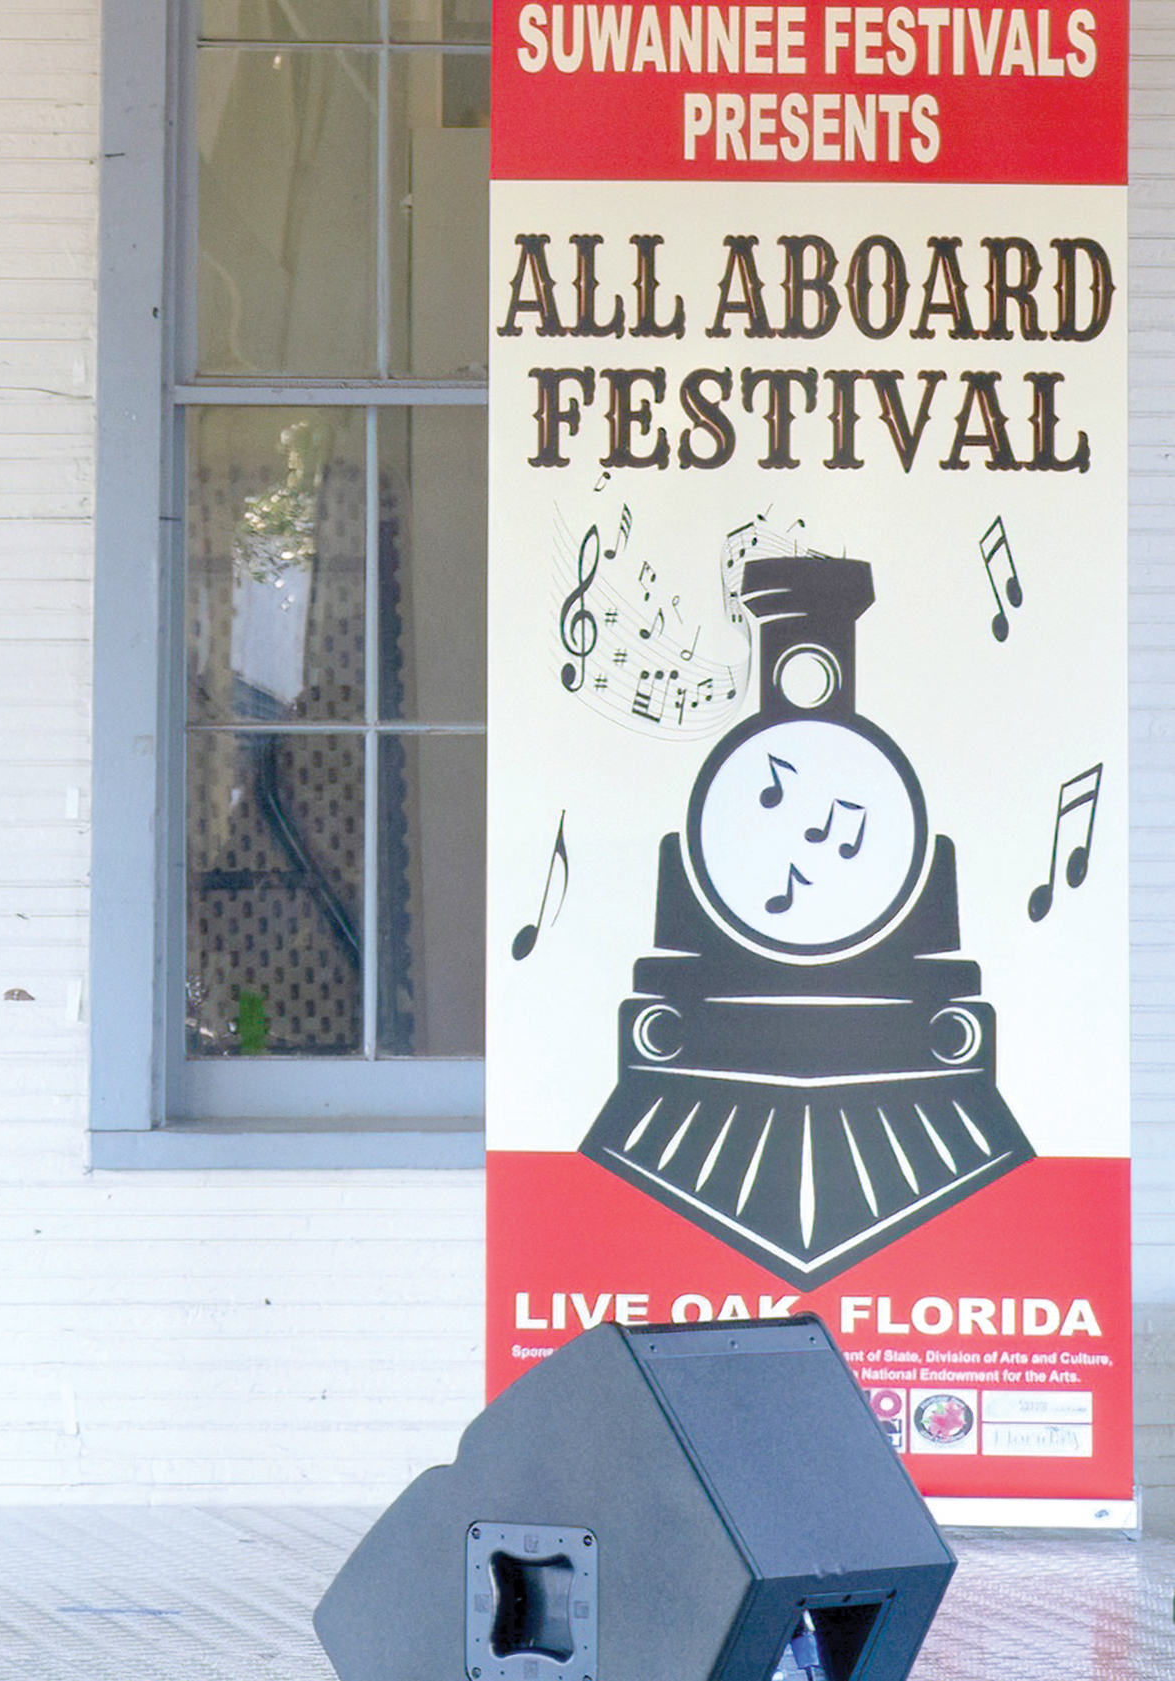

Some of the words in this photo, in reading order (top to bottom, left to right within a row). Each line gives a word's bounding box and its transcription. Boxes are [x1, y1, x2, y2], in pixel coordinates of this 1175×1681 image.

[517, 3, 807, 74] SUWANNEE
[824, 6, 1098, 78] FESTIVALS
[684, 92, 941, 164] PRESENTS
[496, 233, 686, 340] ALL
[704, 234, 1117, 343] ABOARD
[527, 365, 1092, 474] FESTIVAL
[515, 1291, 650, 1330] LIVE
[671, 1294, 801, 1323] OAK
[840, 1296, 1102, 1337] FLORIDA
[861, 1367, 918, 1381] National
[920, 1368, 1000, 1382] Endowment
[1002, 1369, 1022, 1383] for
[1025, 1370, 1047, 1383] the
[1049, 1370, 1082, 1383] Arts.
[867, 1349, 882, 1362] of
[883, 1349, 923, 1364] State,
[926, 1350, 981, 1364] Division
[983, 1351, 999, 1364] of
[1000, 1352, 1029, 1365] Arts
[1031, 1352, 1058, 1365] and
[1060, 1352, 1113, 1367] Culture,
